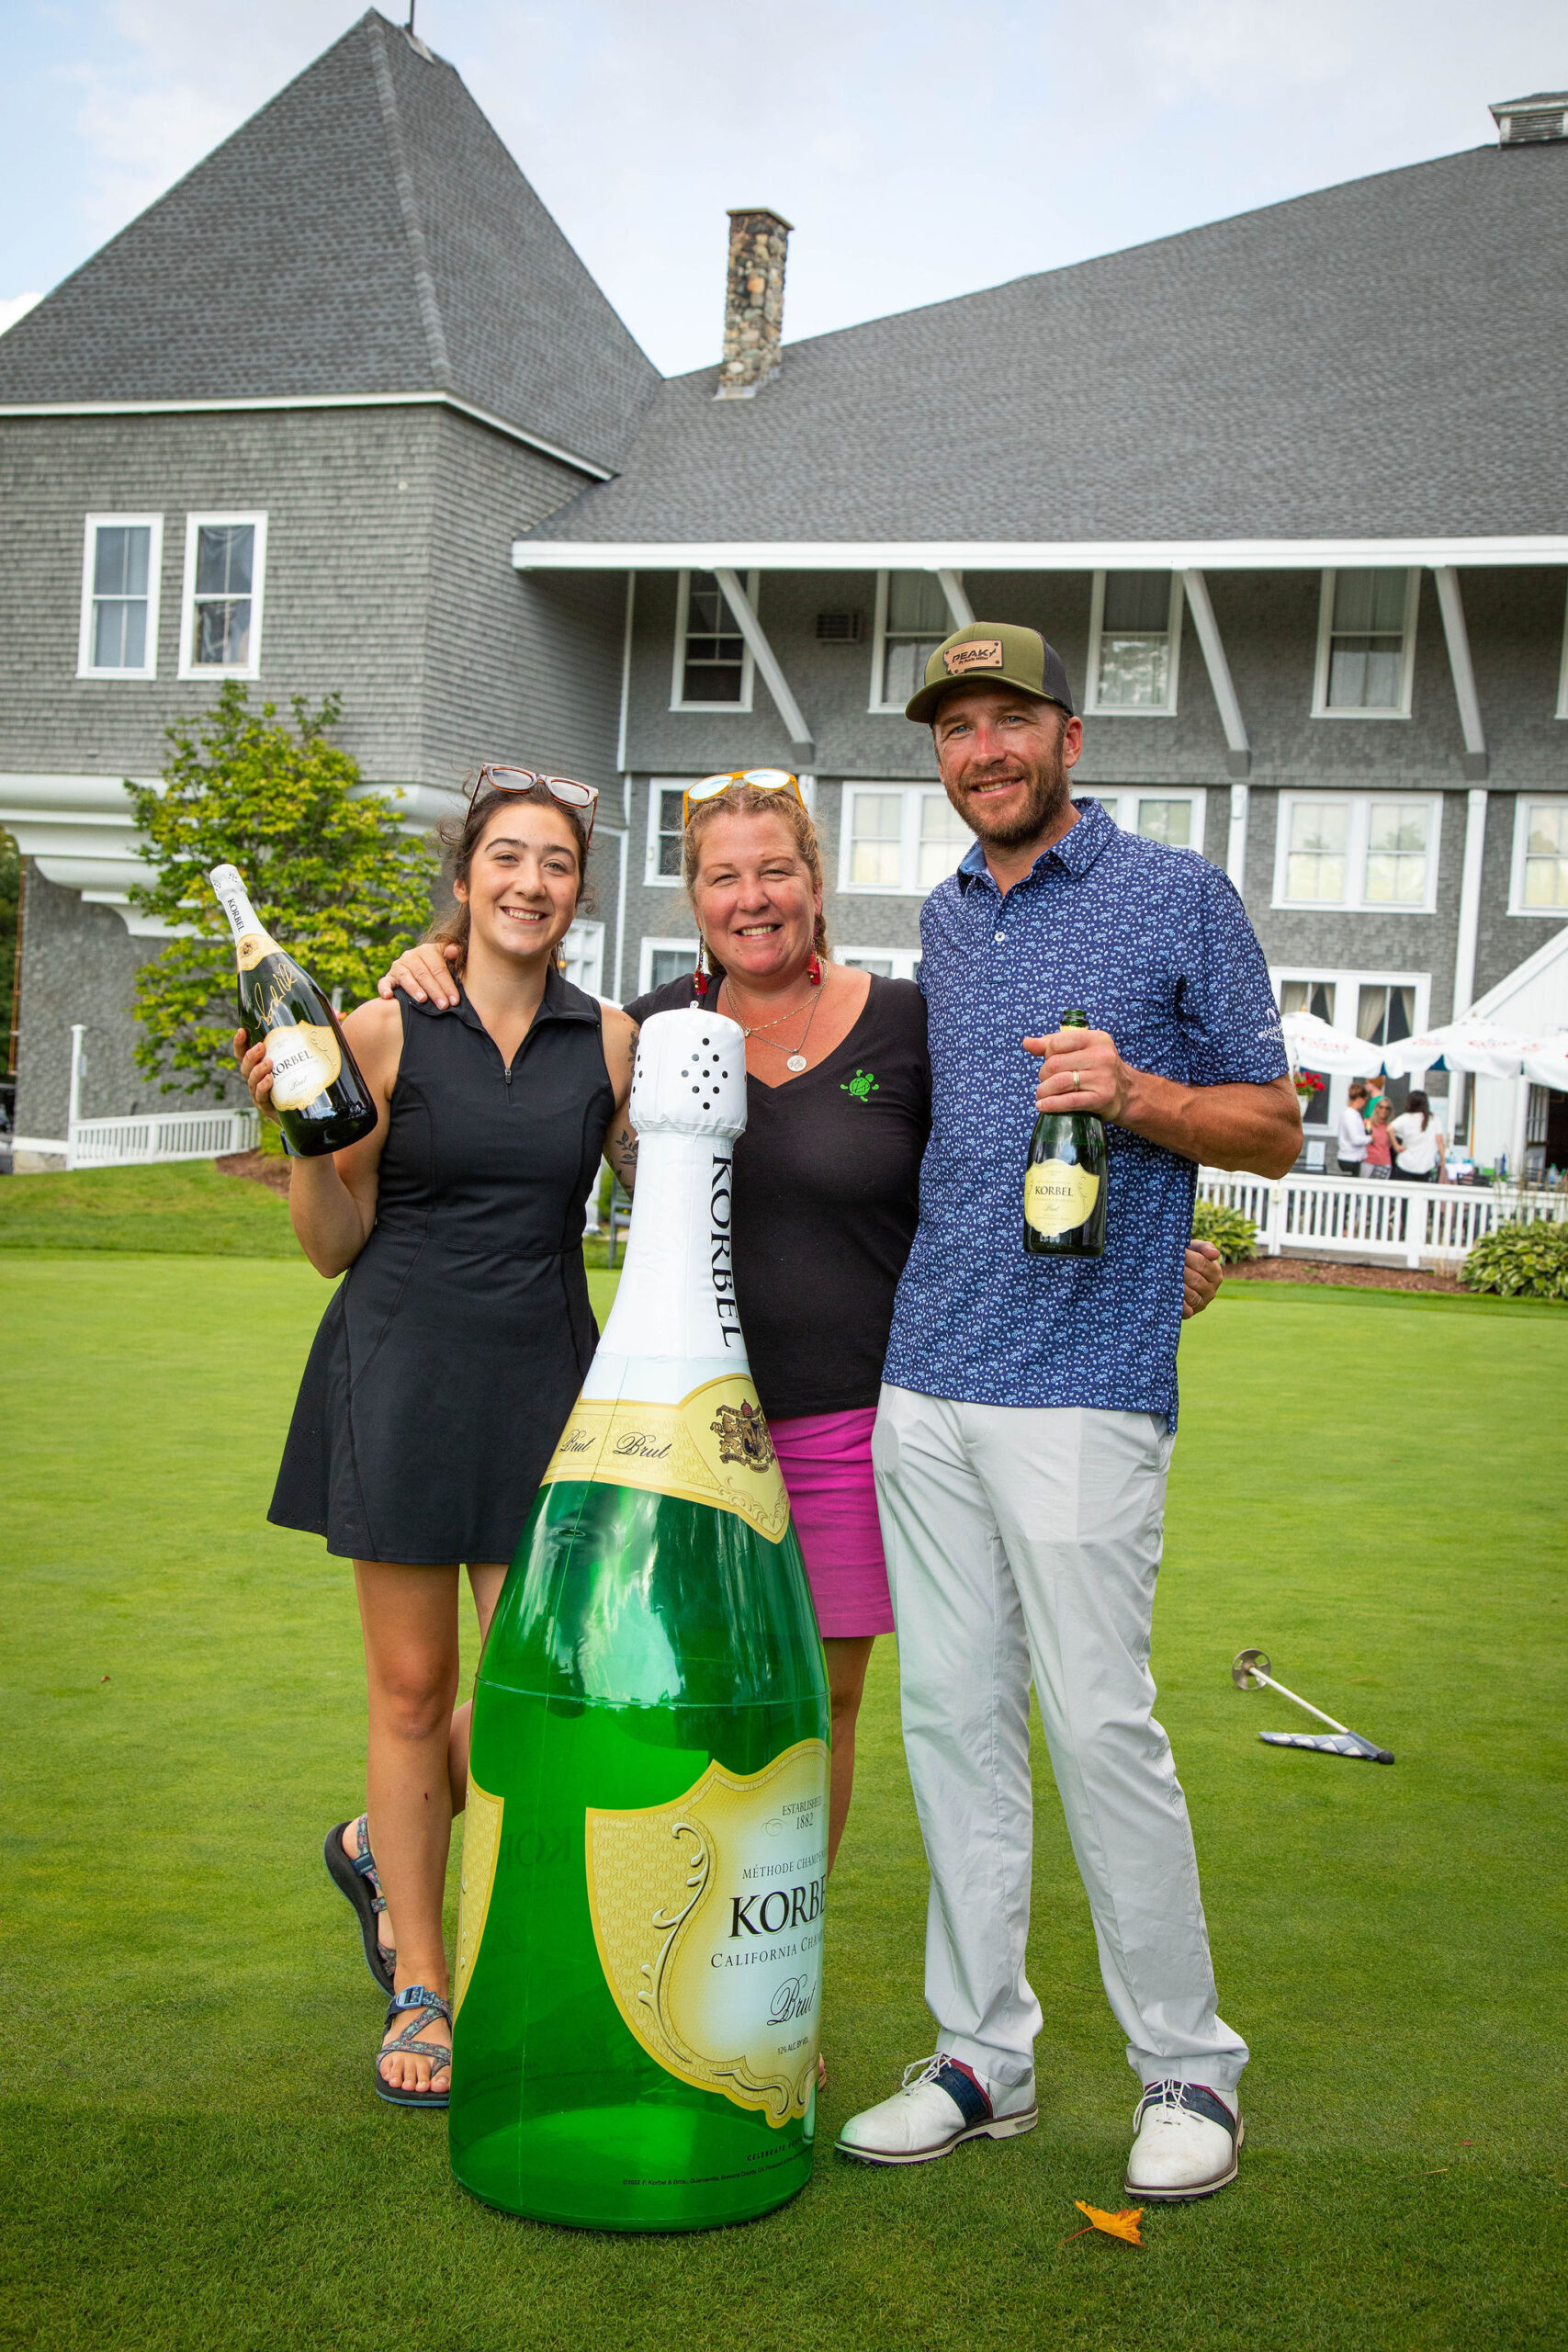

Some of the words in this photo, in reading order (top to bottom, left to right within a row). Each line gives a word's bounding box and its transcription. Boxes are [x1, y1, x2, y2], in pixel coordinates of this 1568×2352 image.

[953, 649, 989, 662] PEAK
[228, 898, 245, 933] KORBEL
[271, 1050, 314, 1079] KORBEL
[1035, 1185, 1074, 1197] KORBEL
[711, 1152, 743, 1348] KORBEL
[558, 1429, 596, 1453] Brut
[612, 1431, 672, 1459] Brut
[796, 1812, 814, 1830] 1882
[742, 1860, 795, 1880] MÉTHODE
[711, 1943, 797, 1968] CALIFORNIA
[767, 1973, 818, 2026] Brut
[747, 2144, 786, 2161] CELEBRATE
